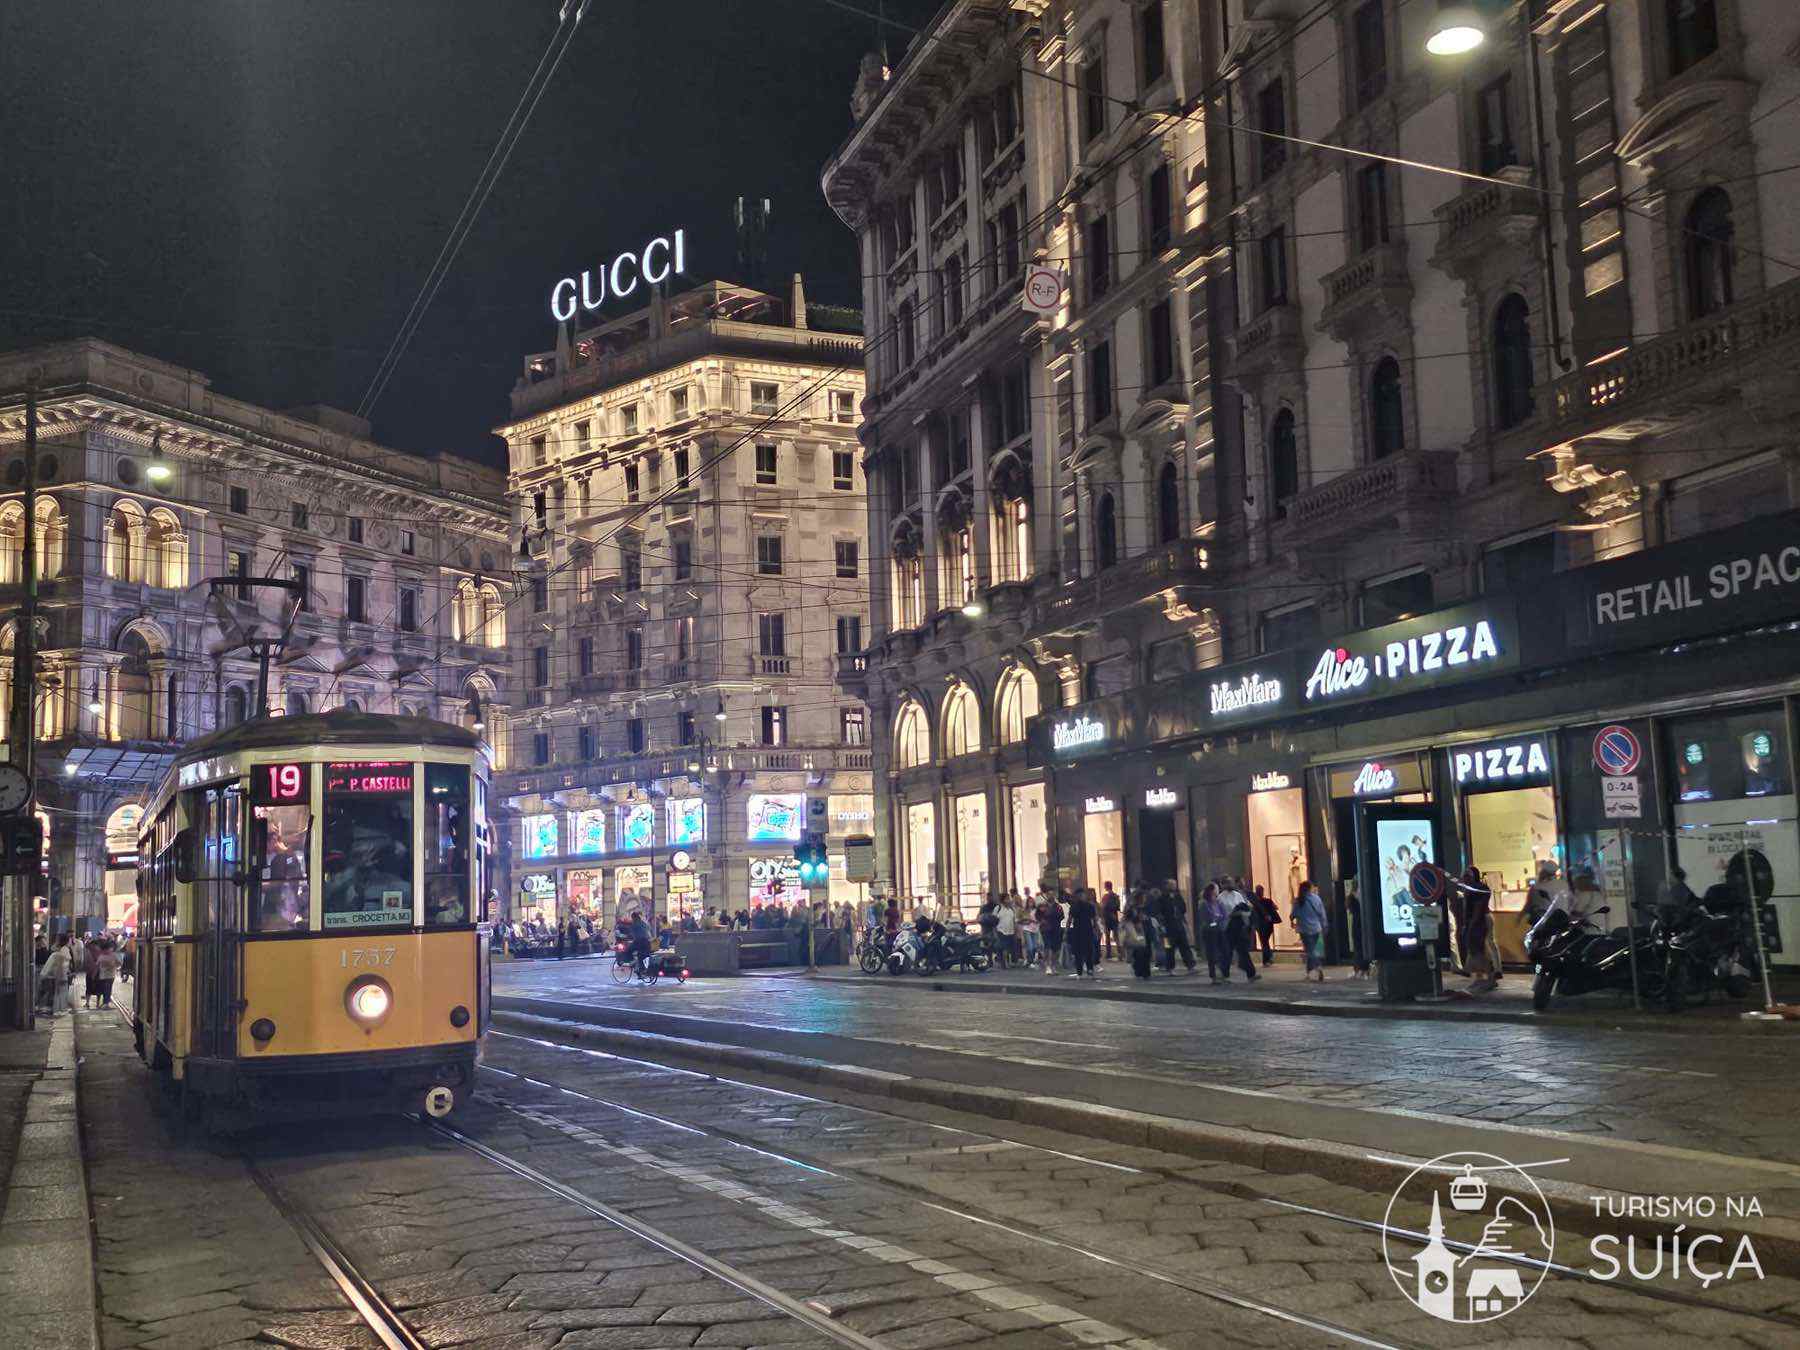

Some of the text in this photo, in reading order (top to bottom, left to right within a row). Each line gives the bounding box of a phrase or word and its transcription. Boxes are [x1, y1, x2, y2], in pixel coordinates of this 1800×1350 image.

[551, 228, 684, 322] GUCCI
[1596, 575, 1703, 625] RETAIL
[1305, 621, 1497, 699] Alice PIZZA
[1210, 673, 1281, 714] MaxMara
[1053, 716, 1104, 750] MaxMara
[1353, 762, 1395, 794] Alice
[1455, 743, 1548, 782] PIZZA
[269, 765, 301, 799] 19
[361, 776, 412, 791] CASTELLI
[1606, 781, 1635, 793] 0-24
